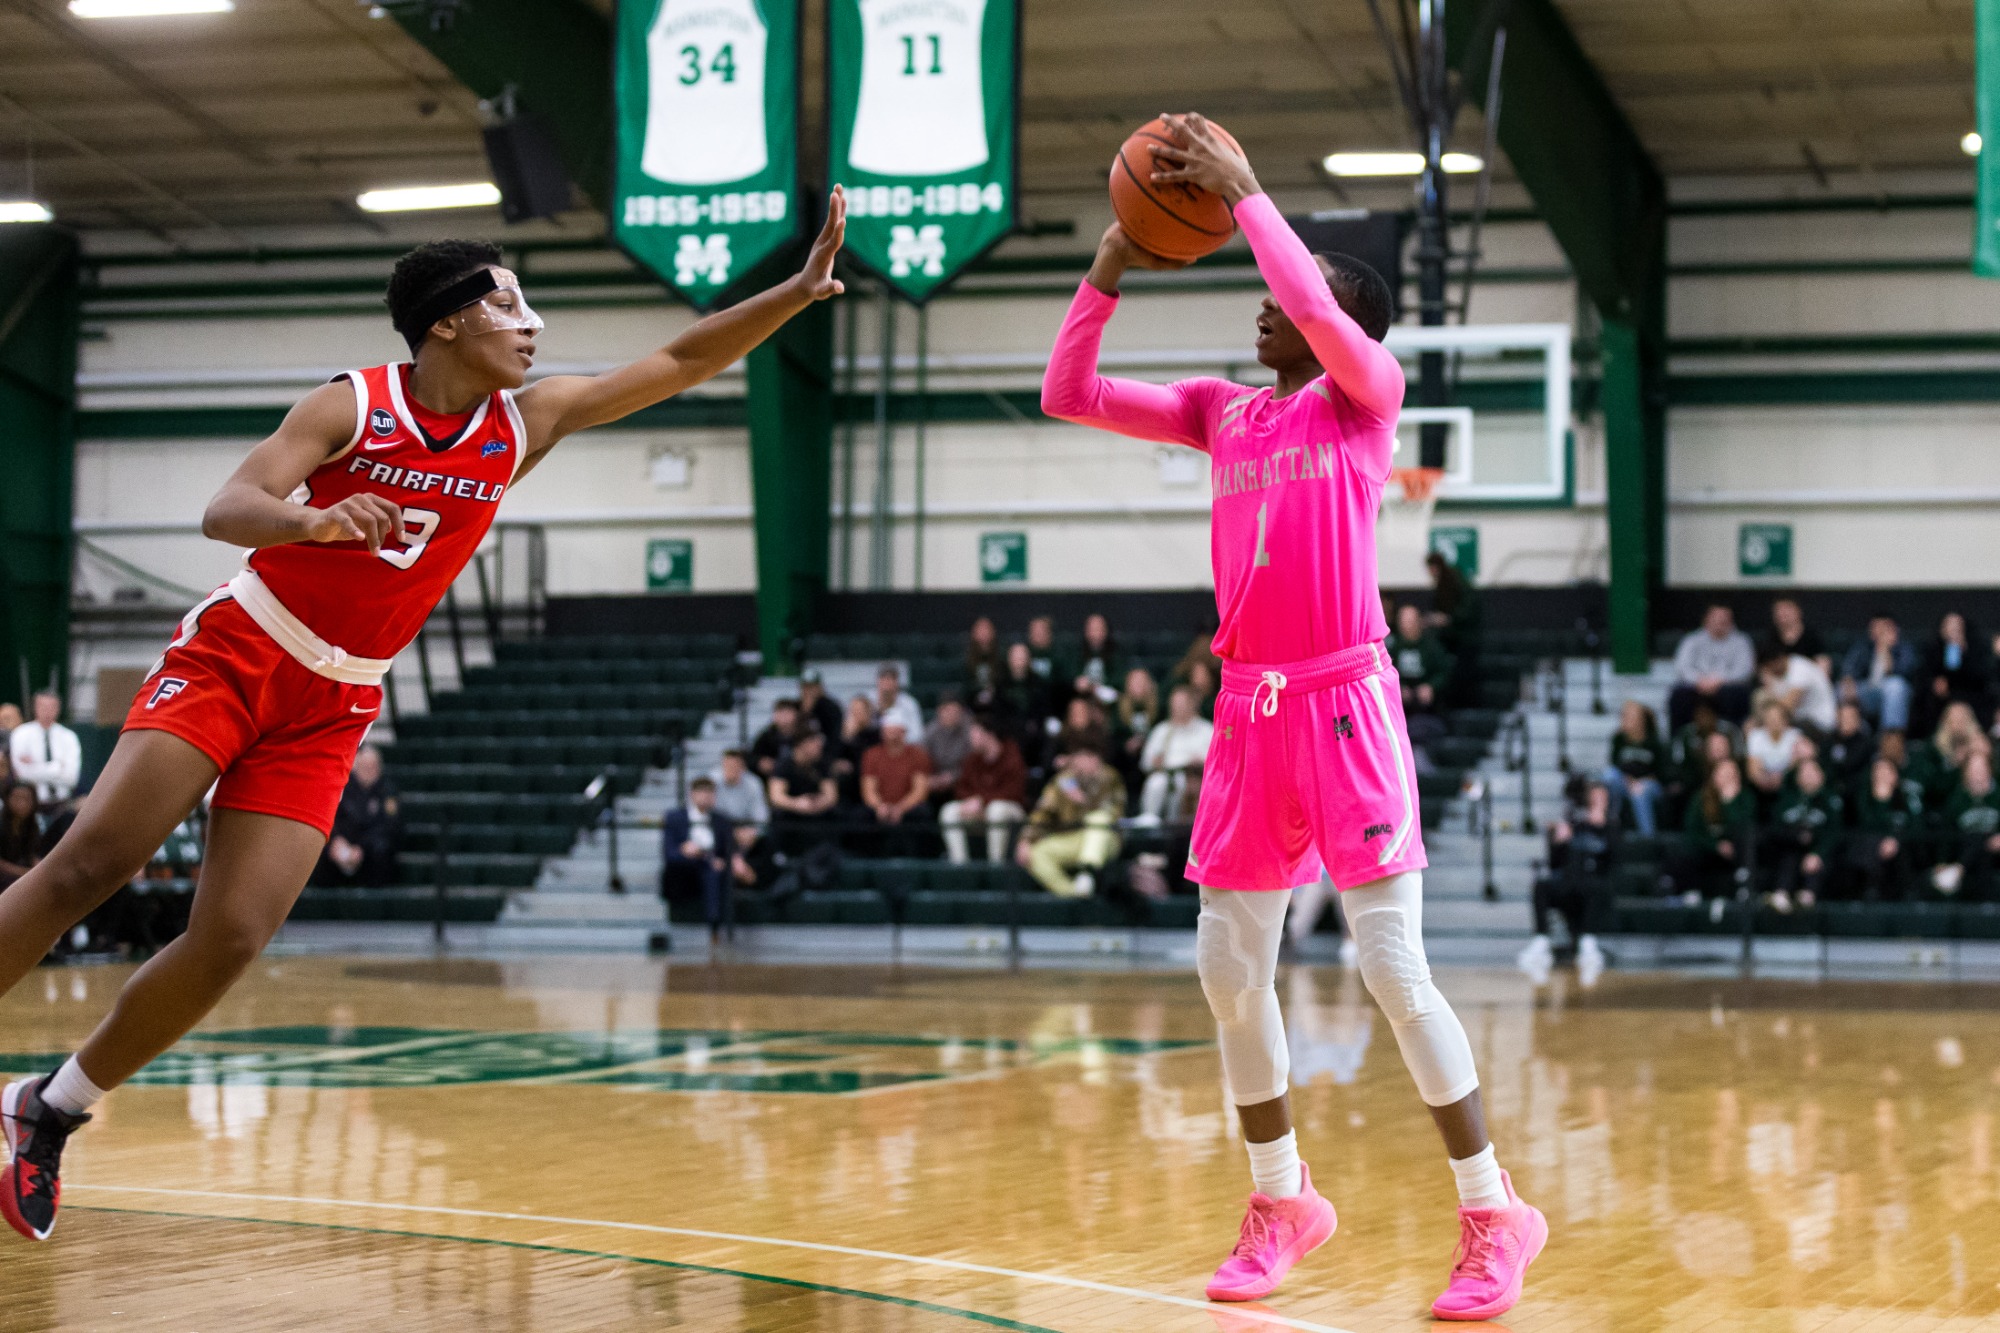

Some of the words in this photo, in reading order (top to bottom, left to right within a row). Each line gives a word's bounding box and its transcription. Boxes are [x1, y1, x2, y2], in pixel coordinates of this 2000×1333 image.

[677, 43, 737, 85] 34
[899, 34, 943, 76] 11
[674, 233, 732, 286] M
[888, 224, 946, 278] M
[348, 455, 504, 502] FAIRFIELD
[1213, 442, 1333, 500] MANHATTAN
[1254, 502, 1270, 567] 1
[145, 677, 190, 709] F
